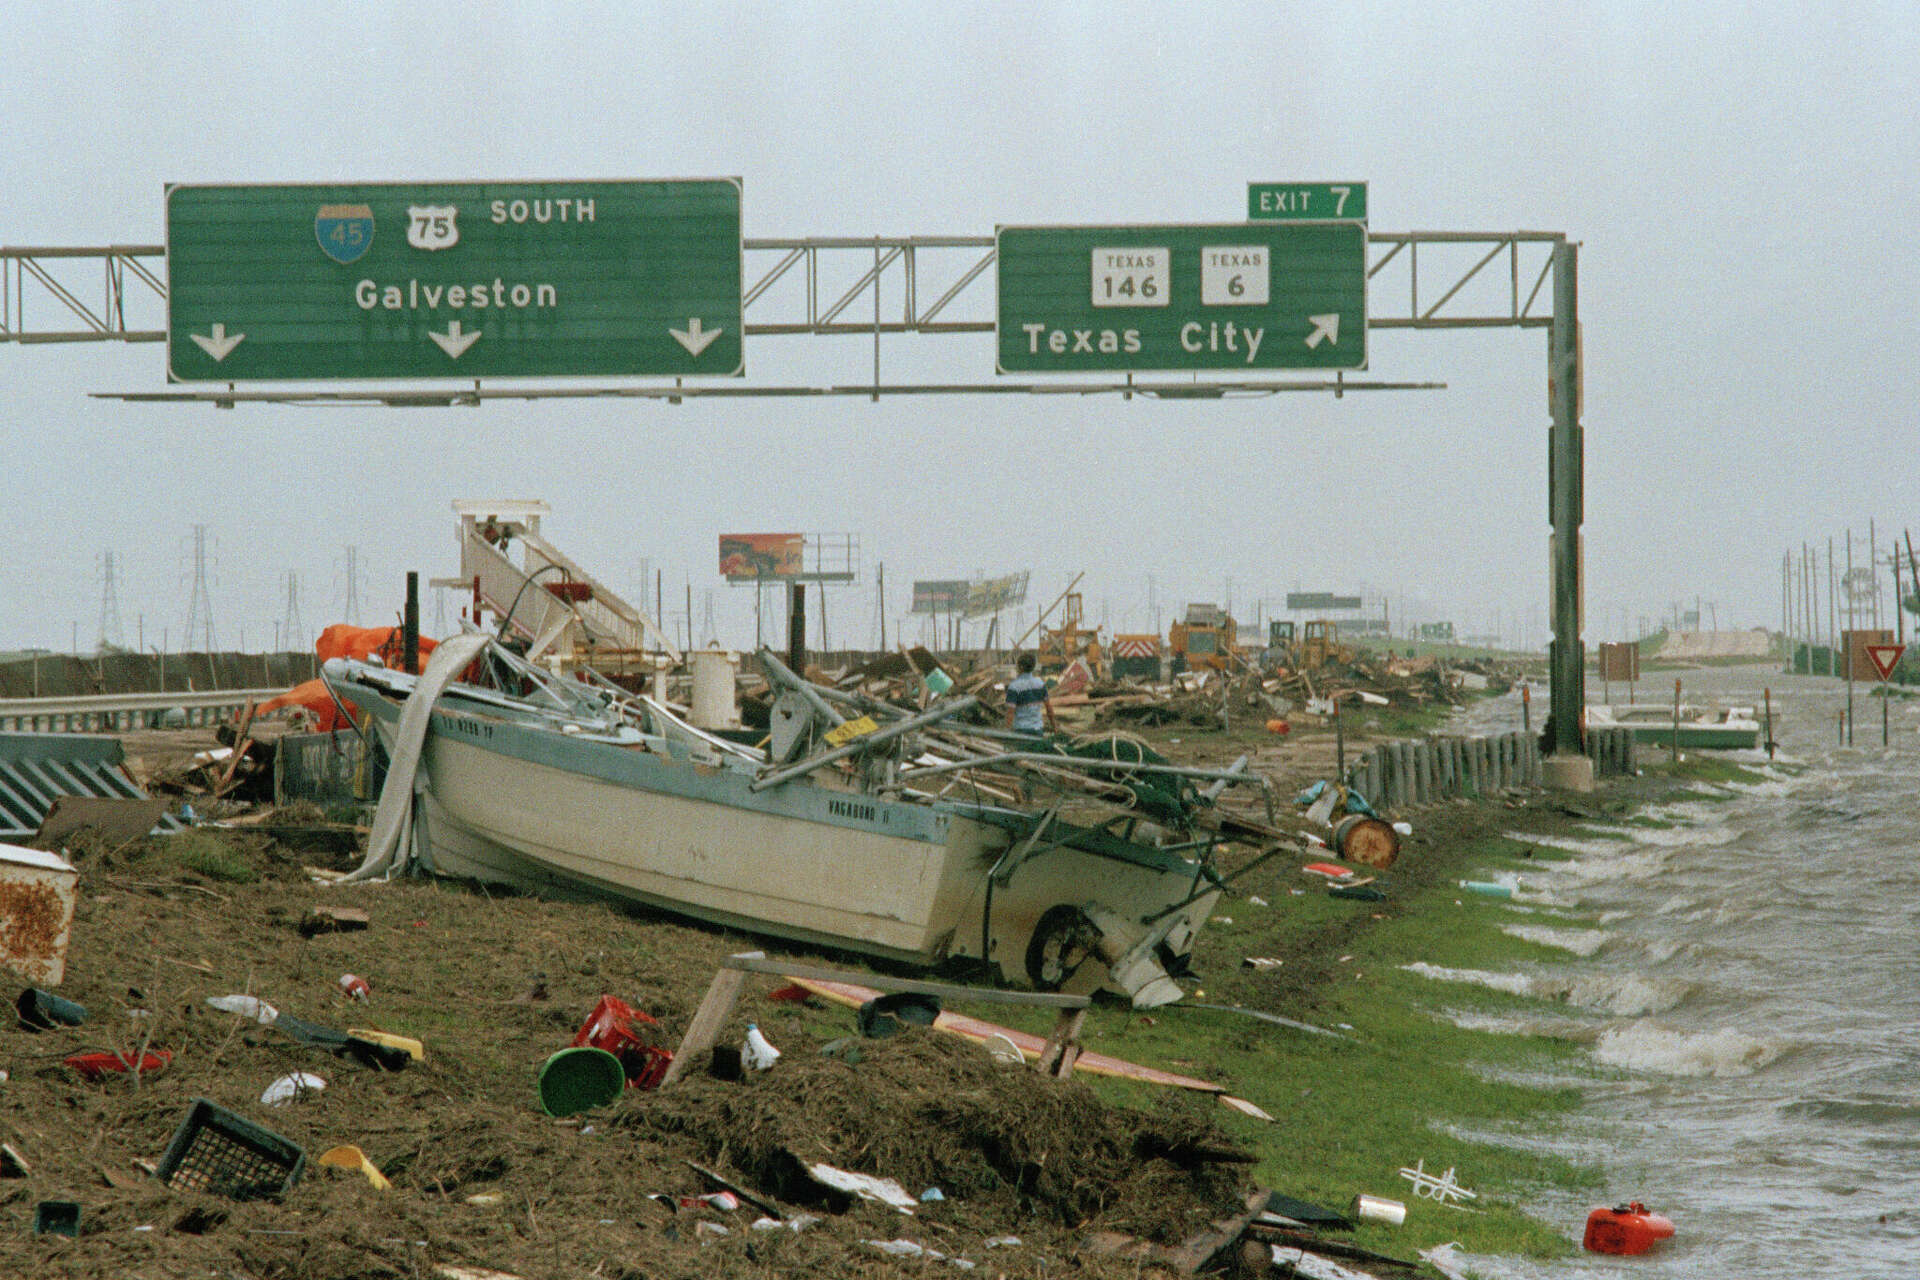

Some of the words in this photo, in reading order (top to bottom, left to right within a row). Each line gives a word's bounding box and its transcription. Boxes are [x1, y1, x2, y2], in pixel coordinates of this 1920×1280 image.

[490, 199, 596, 224] SOUTH
[1260, 192, 1311, 211] EXIT
[1330, 187, 1351, 217] 7
[330, 223, 363, 246] 45
[415, 216, 450, 239] 75
[1106, 254, 1156, 269] TEXAS
[1210, 253, 1262, 267] TEXAS
[355, 278, 557, 310] Galveston
[1104, 276, 1158, 298] 146
[1227, 275, 1245, 297] 6
[1022, 323, 1142, 353] Texas
[1180, 321, 1265, 363] City
